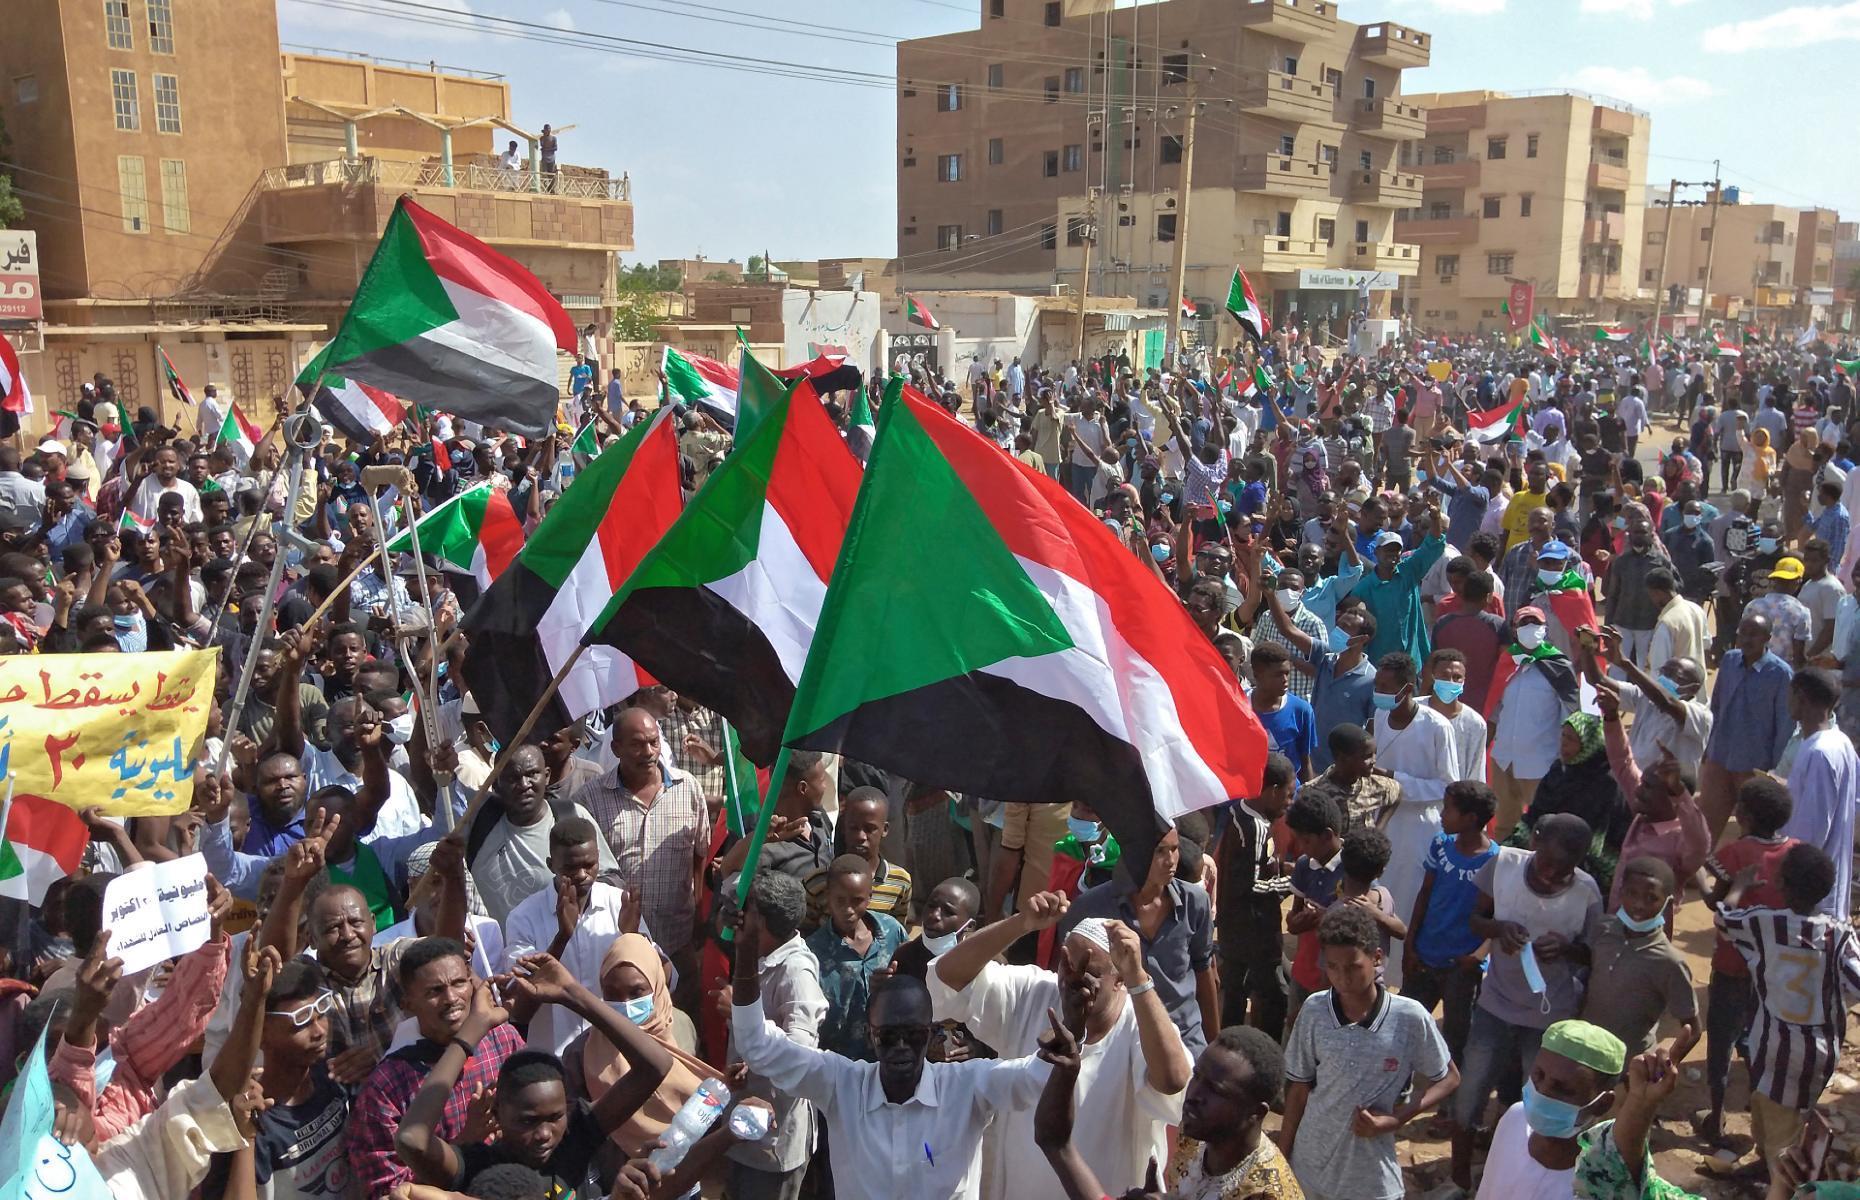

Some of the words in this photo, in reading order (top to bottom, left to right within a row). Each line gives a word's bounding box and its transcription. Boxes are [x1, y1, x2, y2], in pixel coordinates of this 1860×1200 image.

[33, 668, 140, 716] يسقط
[109, 730, 198, 800] مليونية
[1437, 847, 1456, 874] NEW
[158, 879, 205, 903] مليونية
[111, 897, 141, 923] اكتوبر
[1778, 952, 1819, 1024] 3
